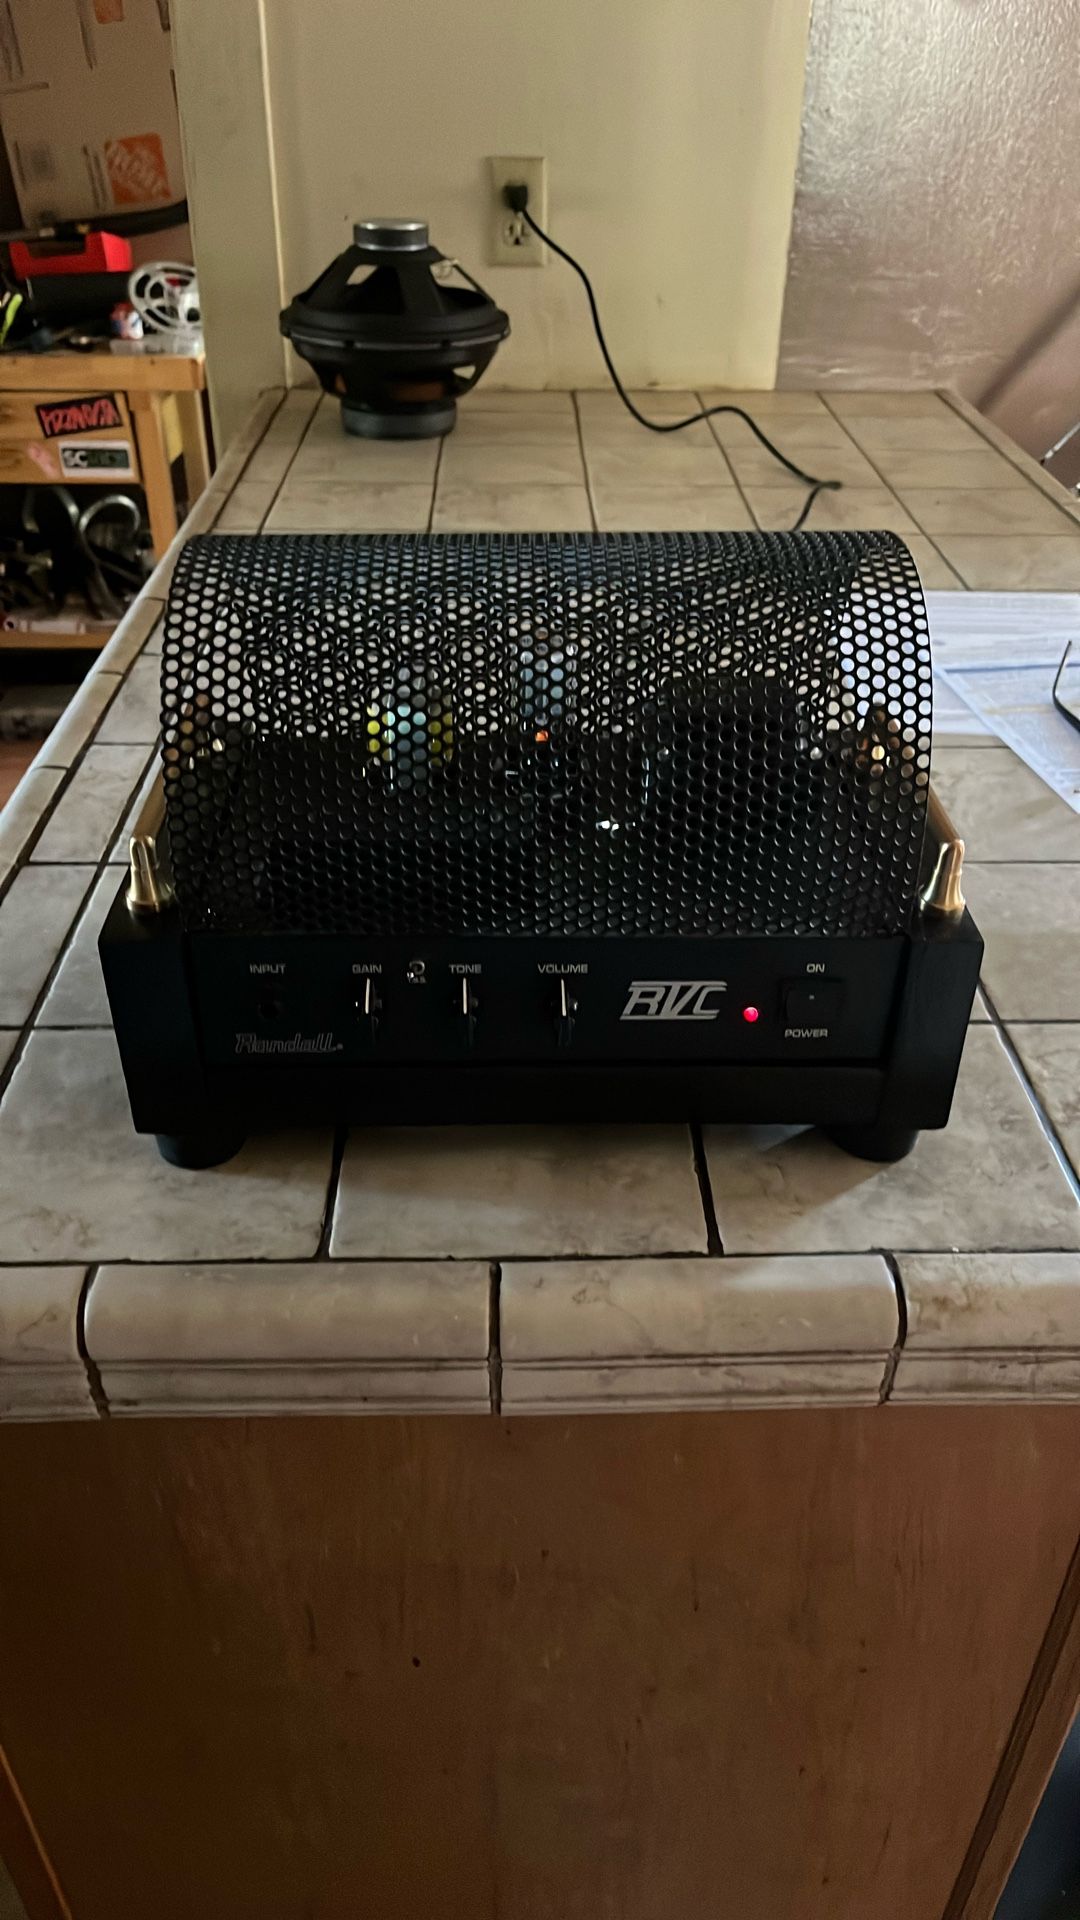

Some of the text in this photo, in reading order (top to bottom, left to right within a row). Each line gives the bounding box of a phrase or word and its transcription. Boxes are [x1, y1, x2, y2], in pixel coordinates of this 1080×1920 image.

[249, 963, 287, 974] INPUT
[352, 963, 382, 974] GAIN
[448, 963, 482, 974] TONE
[537, 963, 588, 974] VOLUME
[806, 963, 825, 973] ON
[619, 980, 728, 1021] RVC
[784, 1028, 828, 1038] POWER
